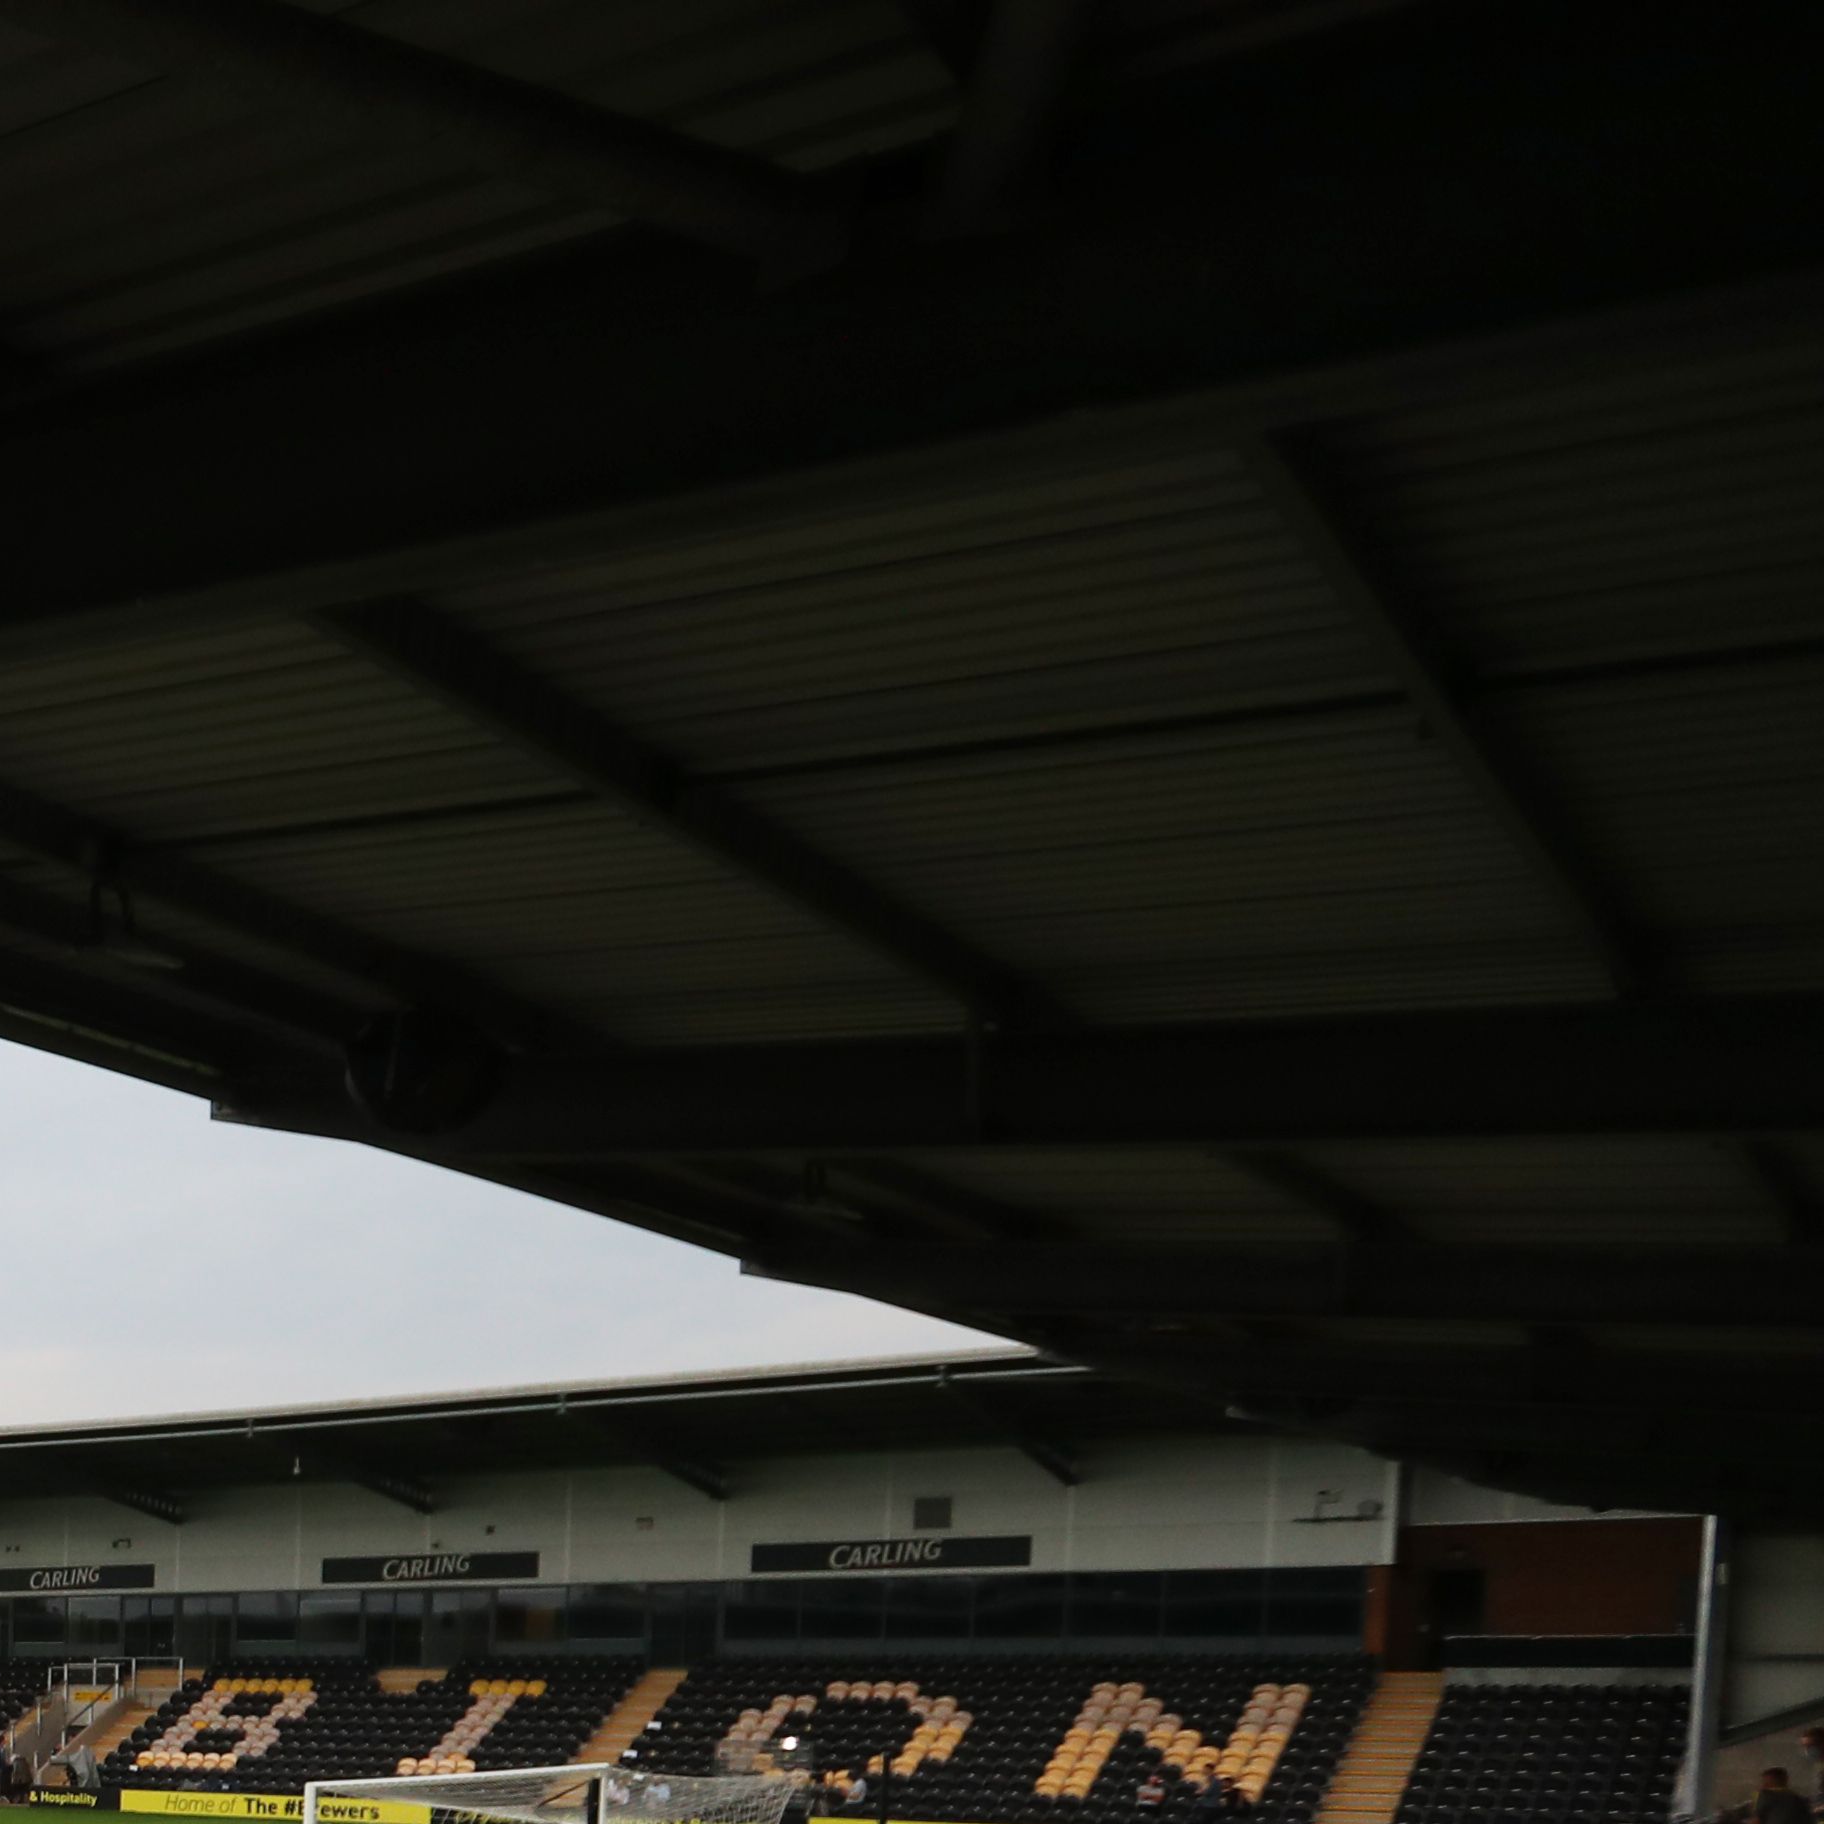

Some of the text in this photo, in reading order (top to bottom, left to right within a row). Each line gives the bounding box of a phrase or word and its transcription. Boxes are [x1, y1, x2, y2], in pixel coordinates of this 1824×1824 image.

[828, 1540, 943, 1570] CARLING
[30, 1567, 100, 1590] CARLING
[383, 1555, 471, 1581] CARLING
[29, 1791, 98, 1807] & Hospitality
[164, 1795, 381, 1820] Home of The #Bewers
